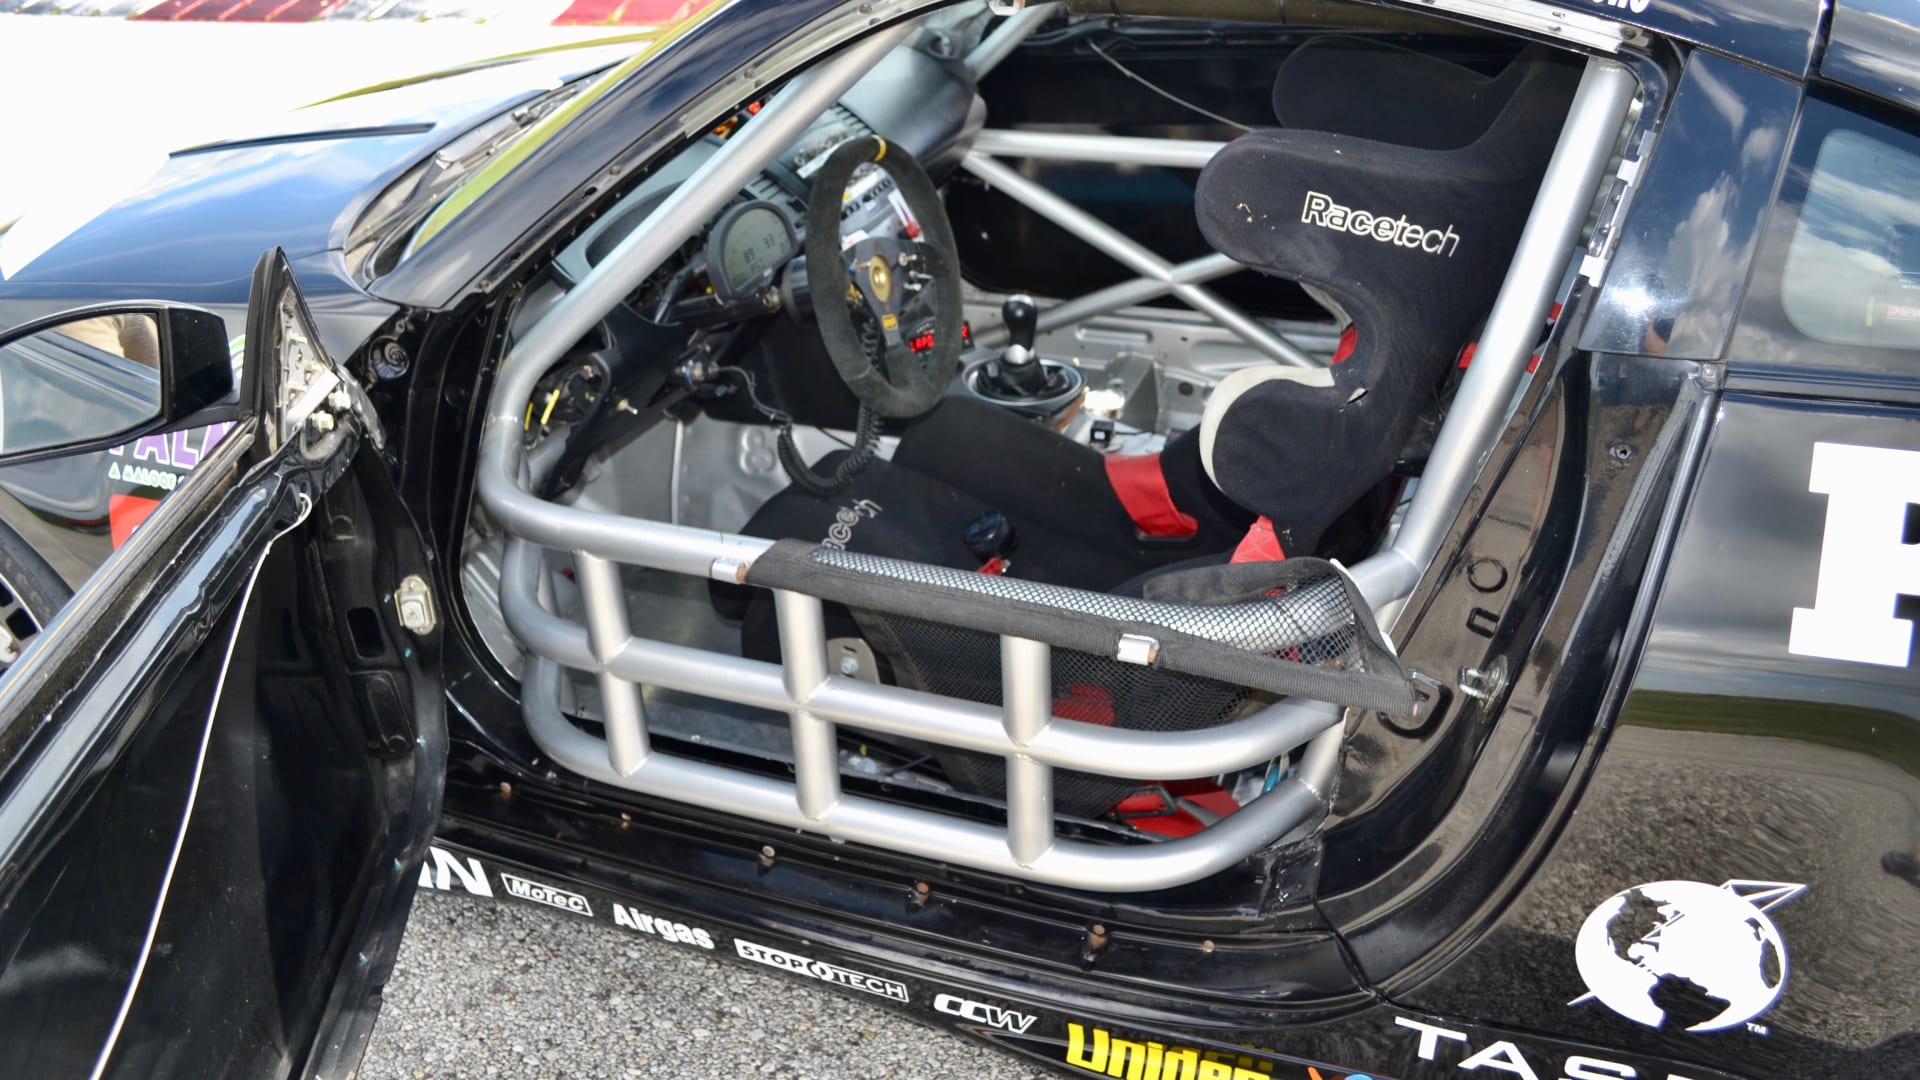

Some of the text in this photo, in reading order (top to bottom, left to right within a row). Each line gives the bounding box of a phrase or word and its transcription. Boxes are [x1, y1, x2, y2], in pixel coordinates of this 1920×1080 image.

[1301, 190, 1460, 257] Racetech
[510, 879, 585, 912] MoTeC
[612, 903, 715, 949] Airgas
[933, 993, 1038, 1034] CCW
[1395, 1016, 1696, 1080] TAS
